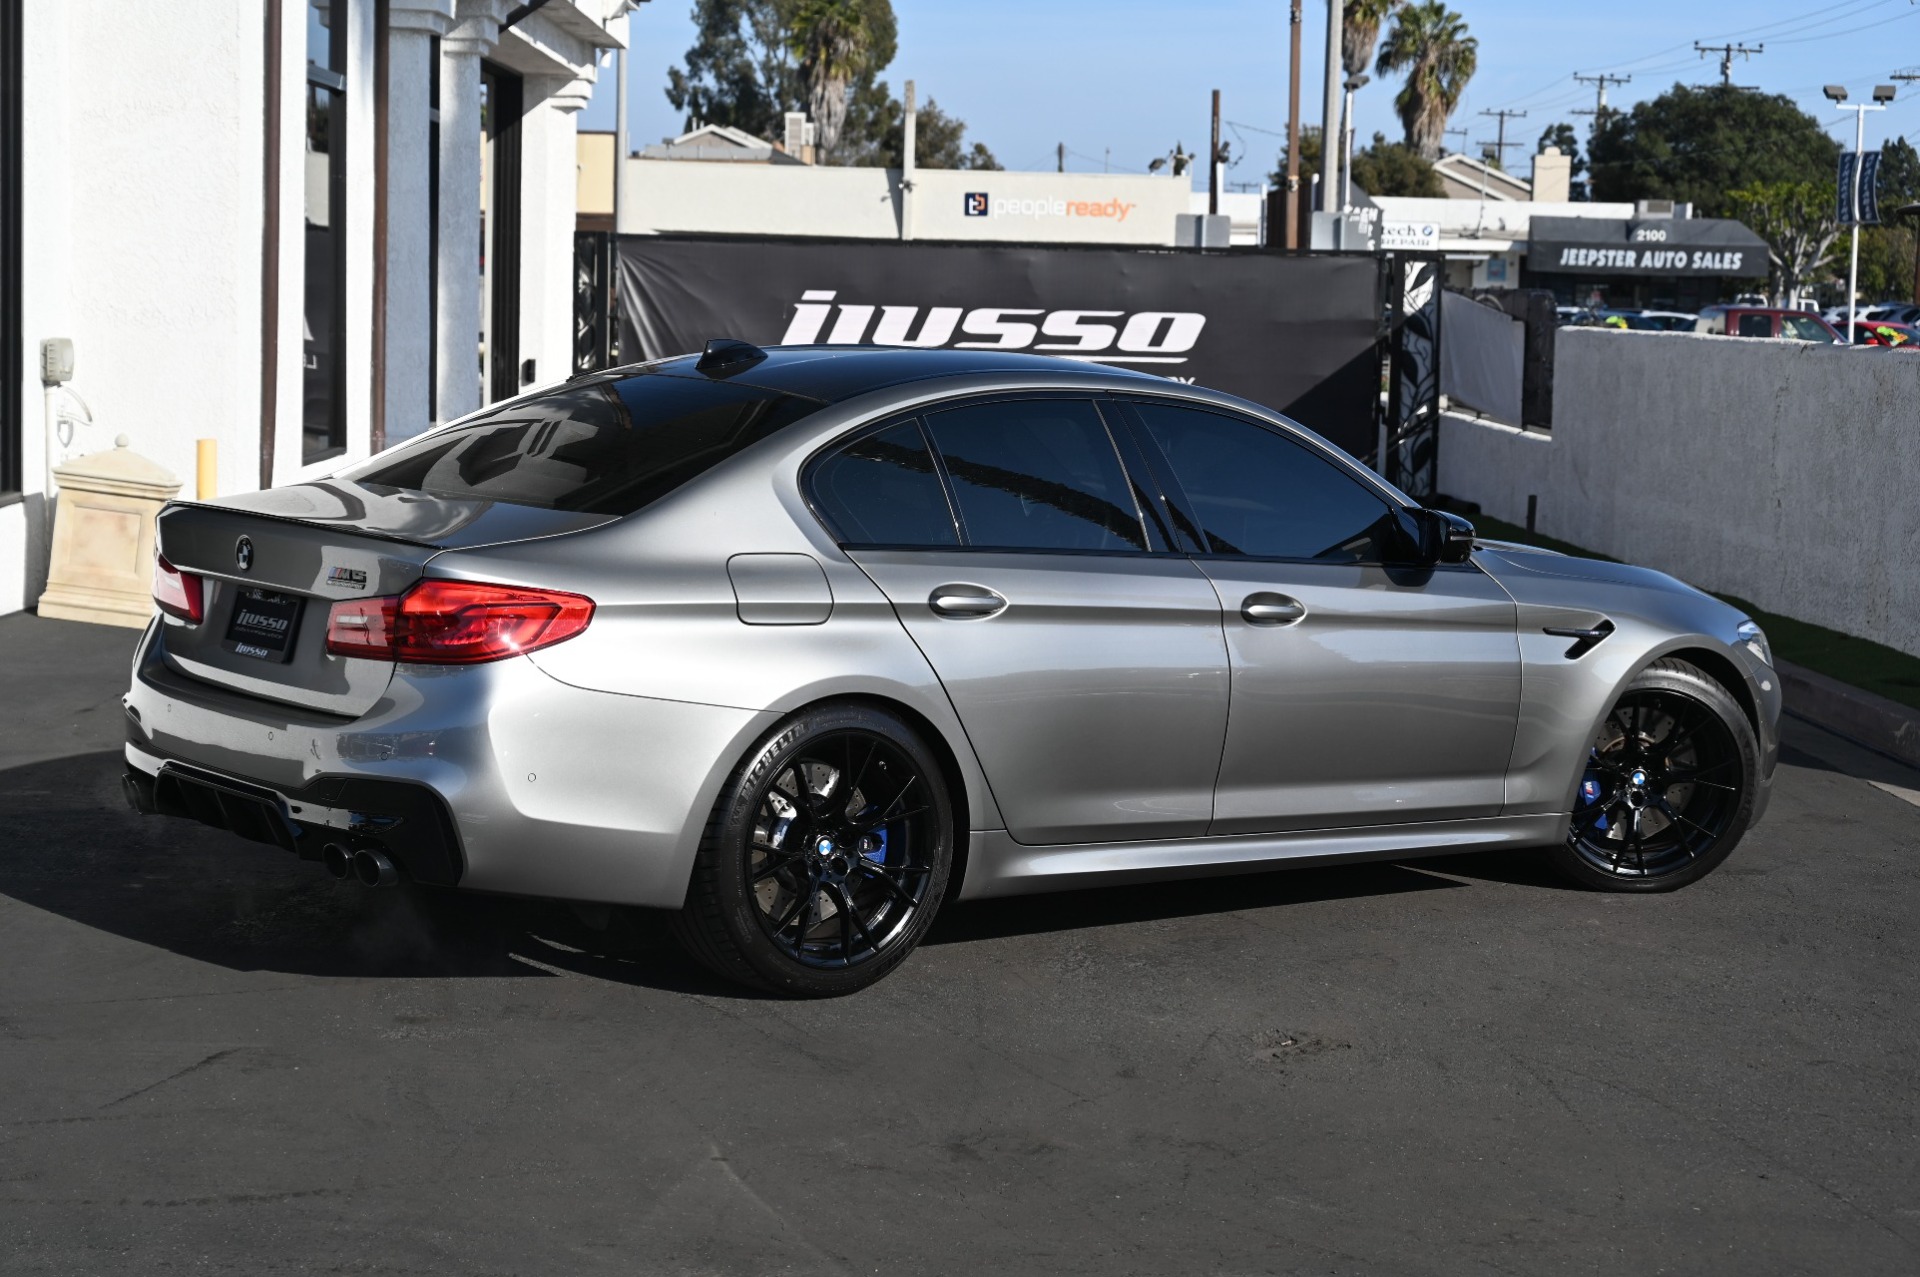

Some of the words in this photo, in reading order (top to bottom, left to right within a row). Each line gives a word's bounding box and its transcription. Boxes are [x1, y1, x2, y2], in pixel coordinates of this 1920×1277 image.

[1636, 229, 1667, 242] 2100
[1560, 248, 1636, 268] JEEPSTER
[1640, 251, 1688, 269] AUTO
[1692, 252, 1743, 270] SALES
[741, 723, 805, 800] MICHELIN
